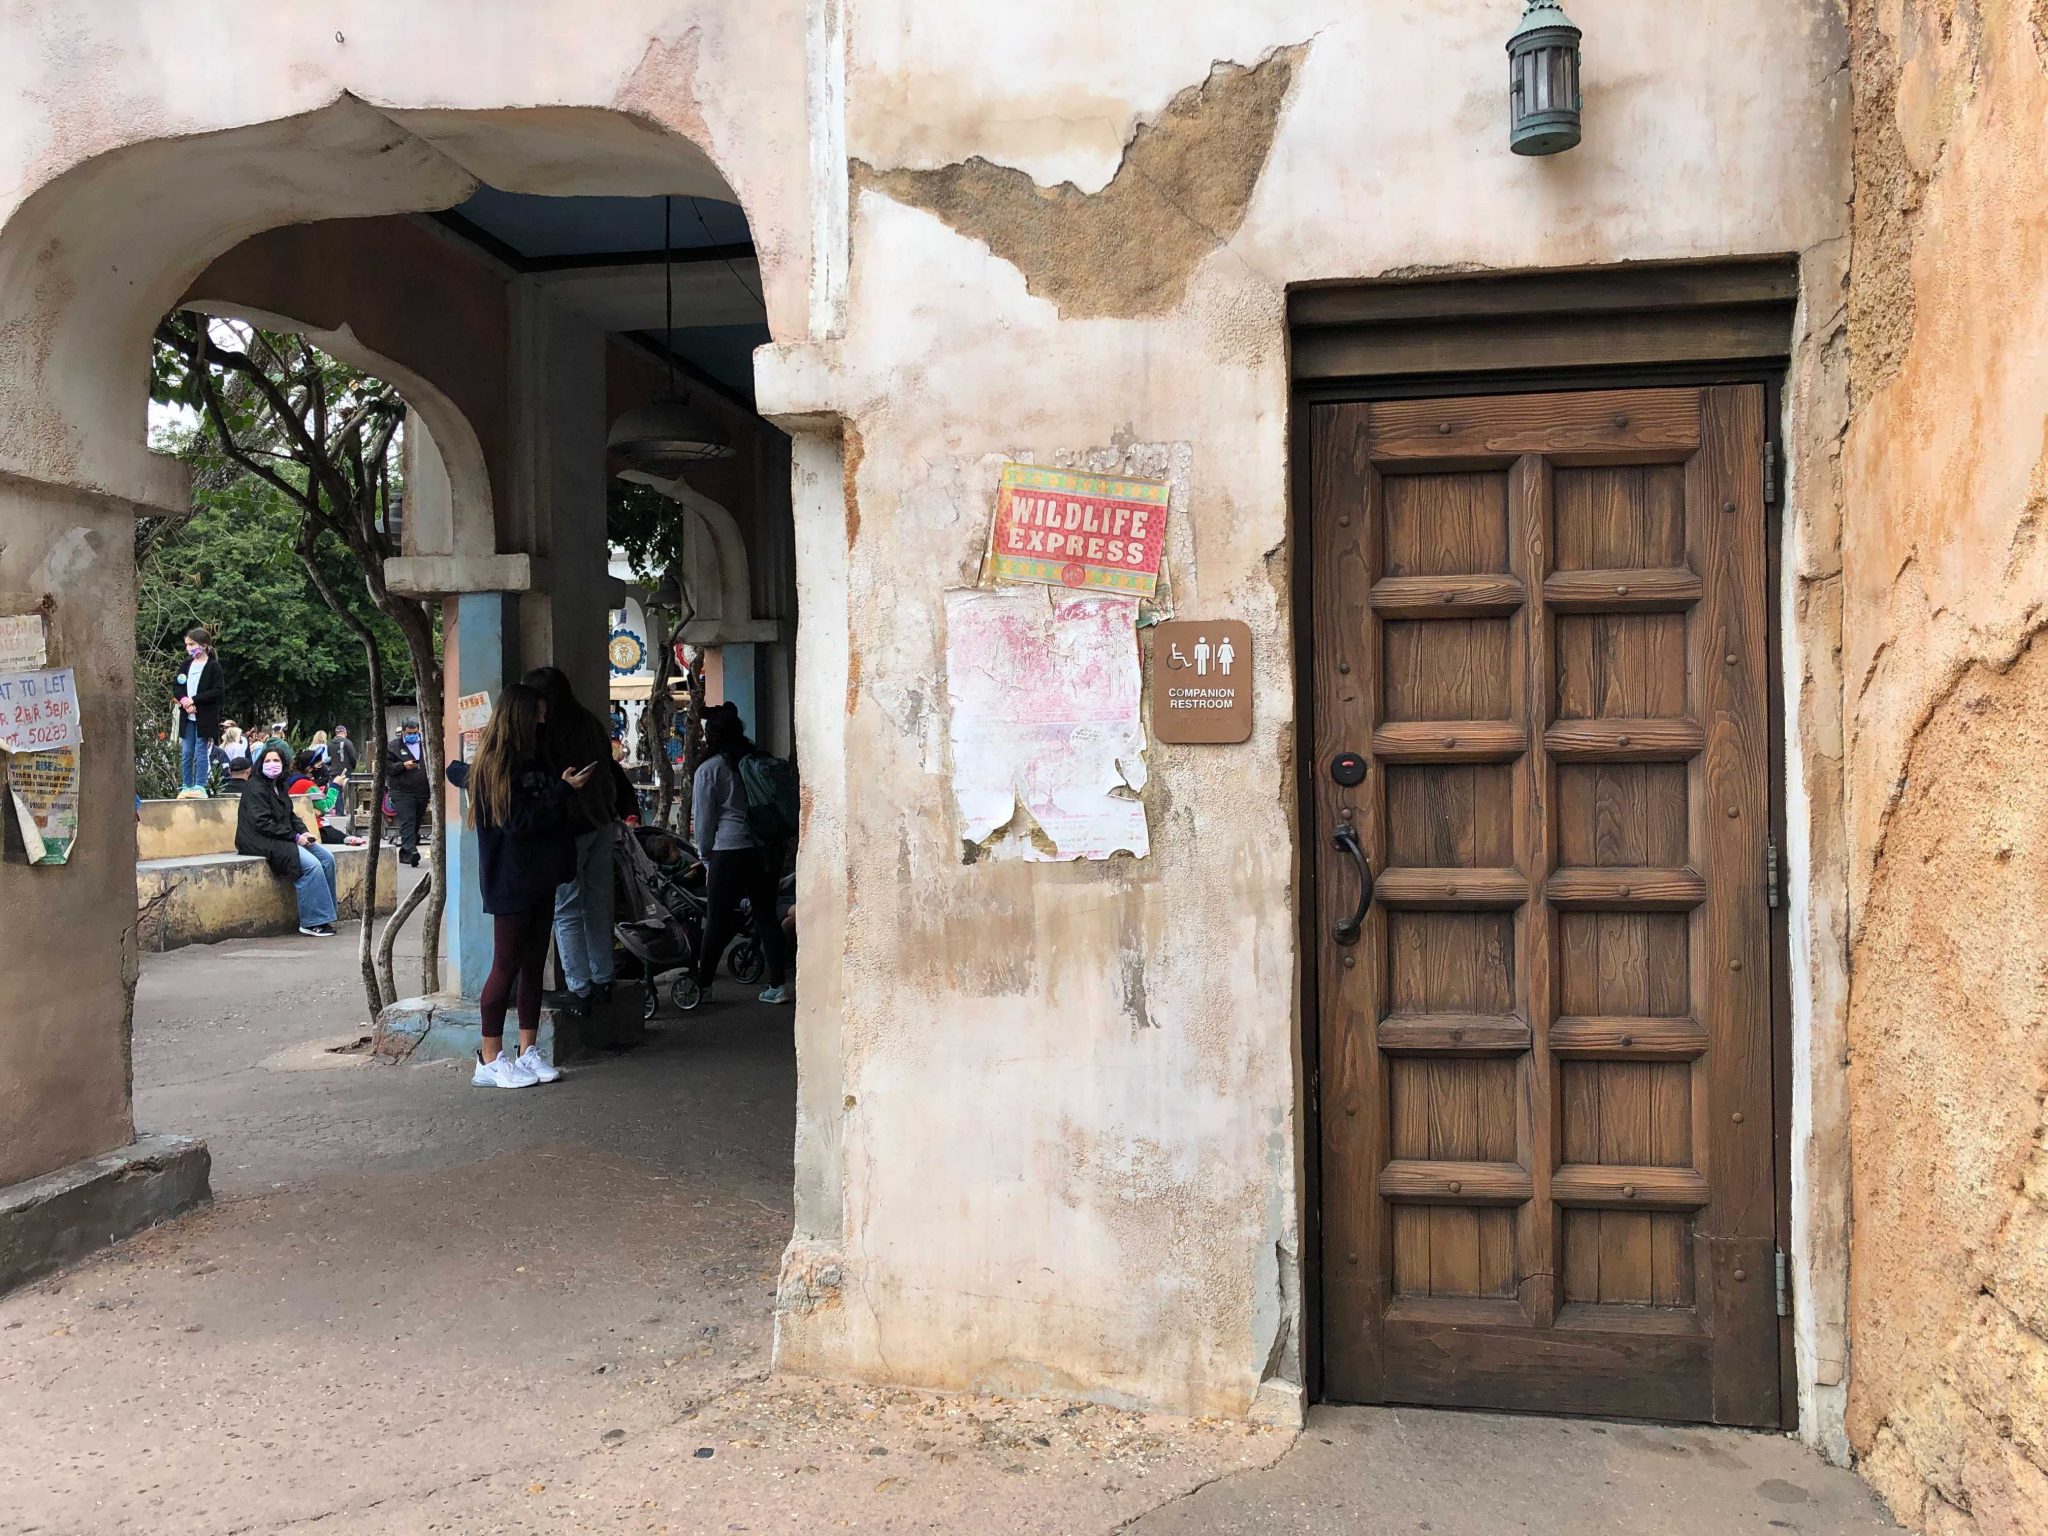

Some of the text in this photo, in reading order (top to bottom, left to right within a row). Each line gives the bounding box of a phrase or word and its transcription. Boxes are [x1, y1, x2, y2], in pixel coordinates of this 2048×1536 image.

[1011, 495, 1149, 539] WILDLIFE
[1007, 527, 1144, 565] EXPRESS
[19, 679, 36, 697] TO
[44, 674, 66, 694] LET
[1168, 688, 1235, 698] COMPANION
[1170, 699, 1233, 709] RESTROOM
[28, 723, 67, 744] 50289
